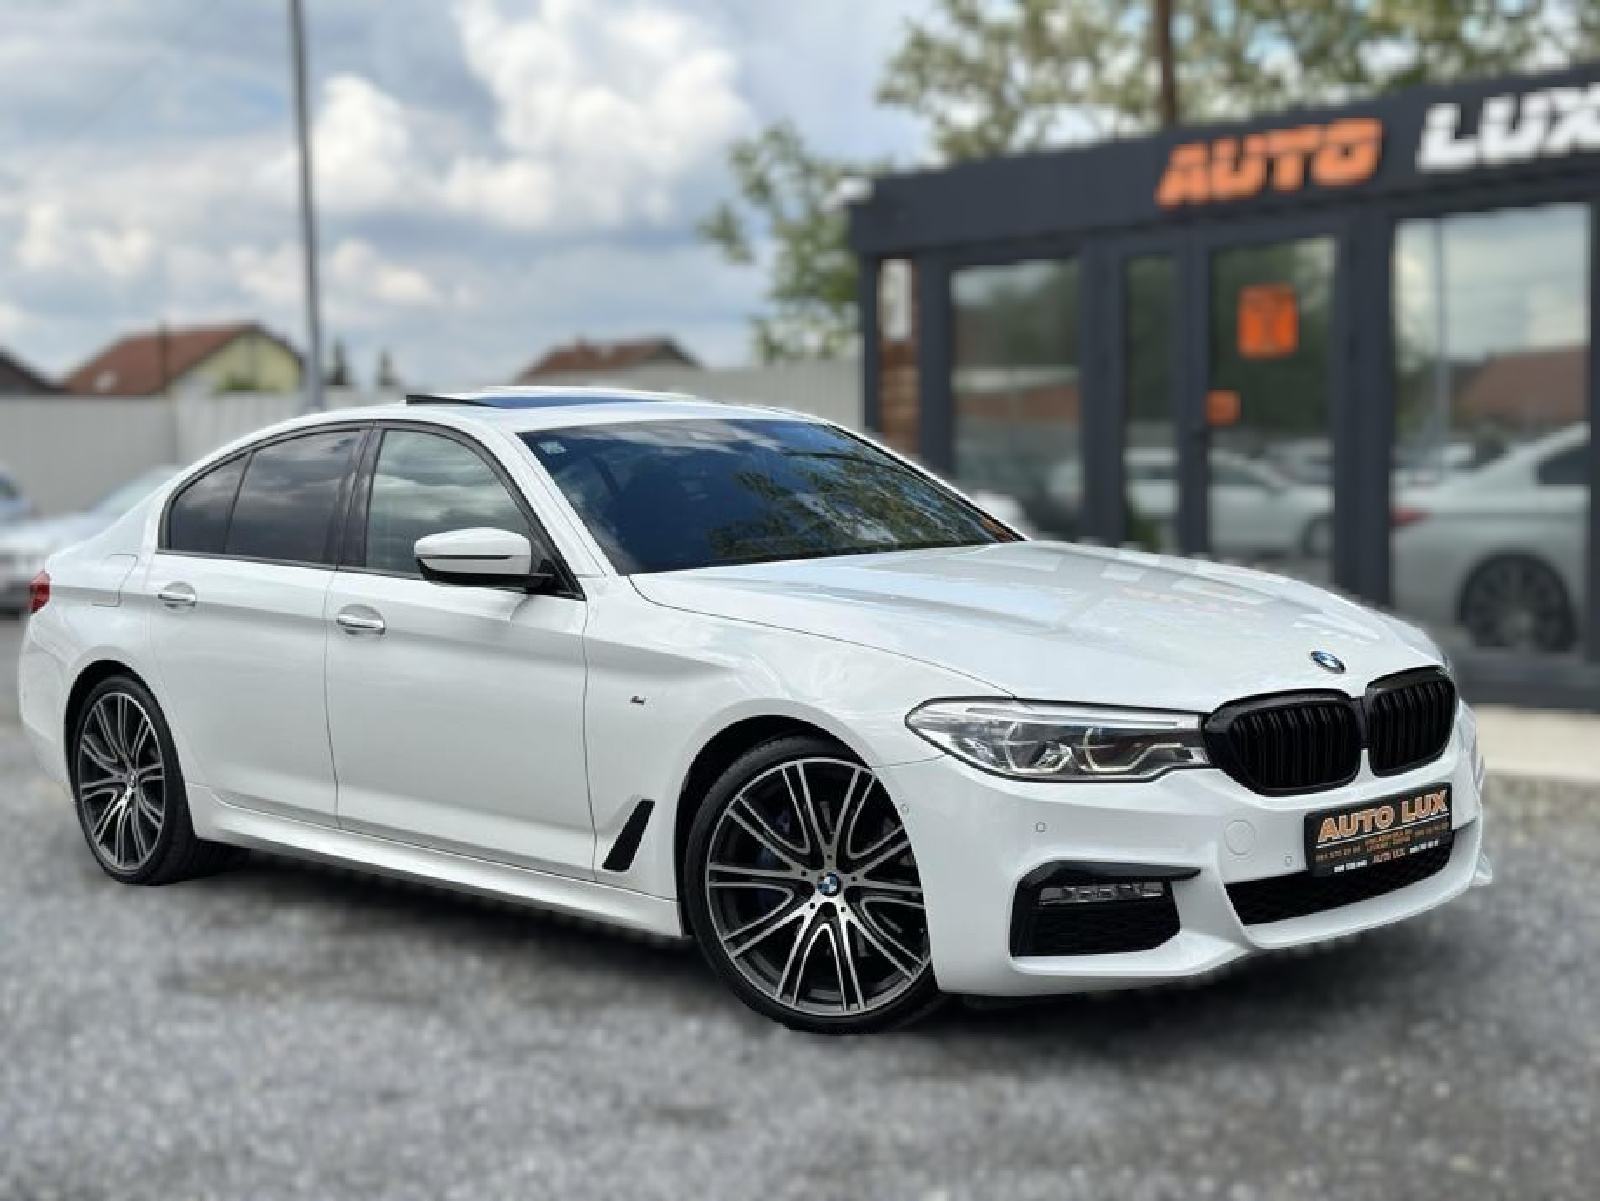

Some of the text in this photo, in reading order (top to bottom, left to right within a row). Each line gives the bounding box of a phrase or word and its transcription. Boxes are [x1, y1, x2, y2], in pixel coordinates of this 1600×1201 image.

[1154, 82, 1600, 209] AUTO LUX
[1318, 805, 1395, 843] AUTO
[1401, 790, 1448, 823] LUX
